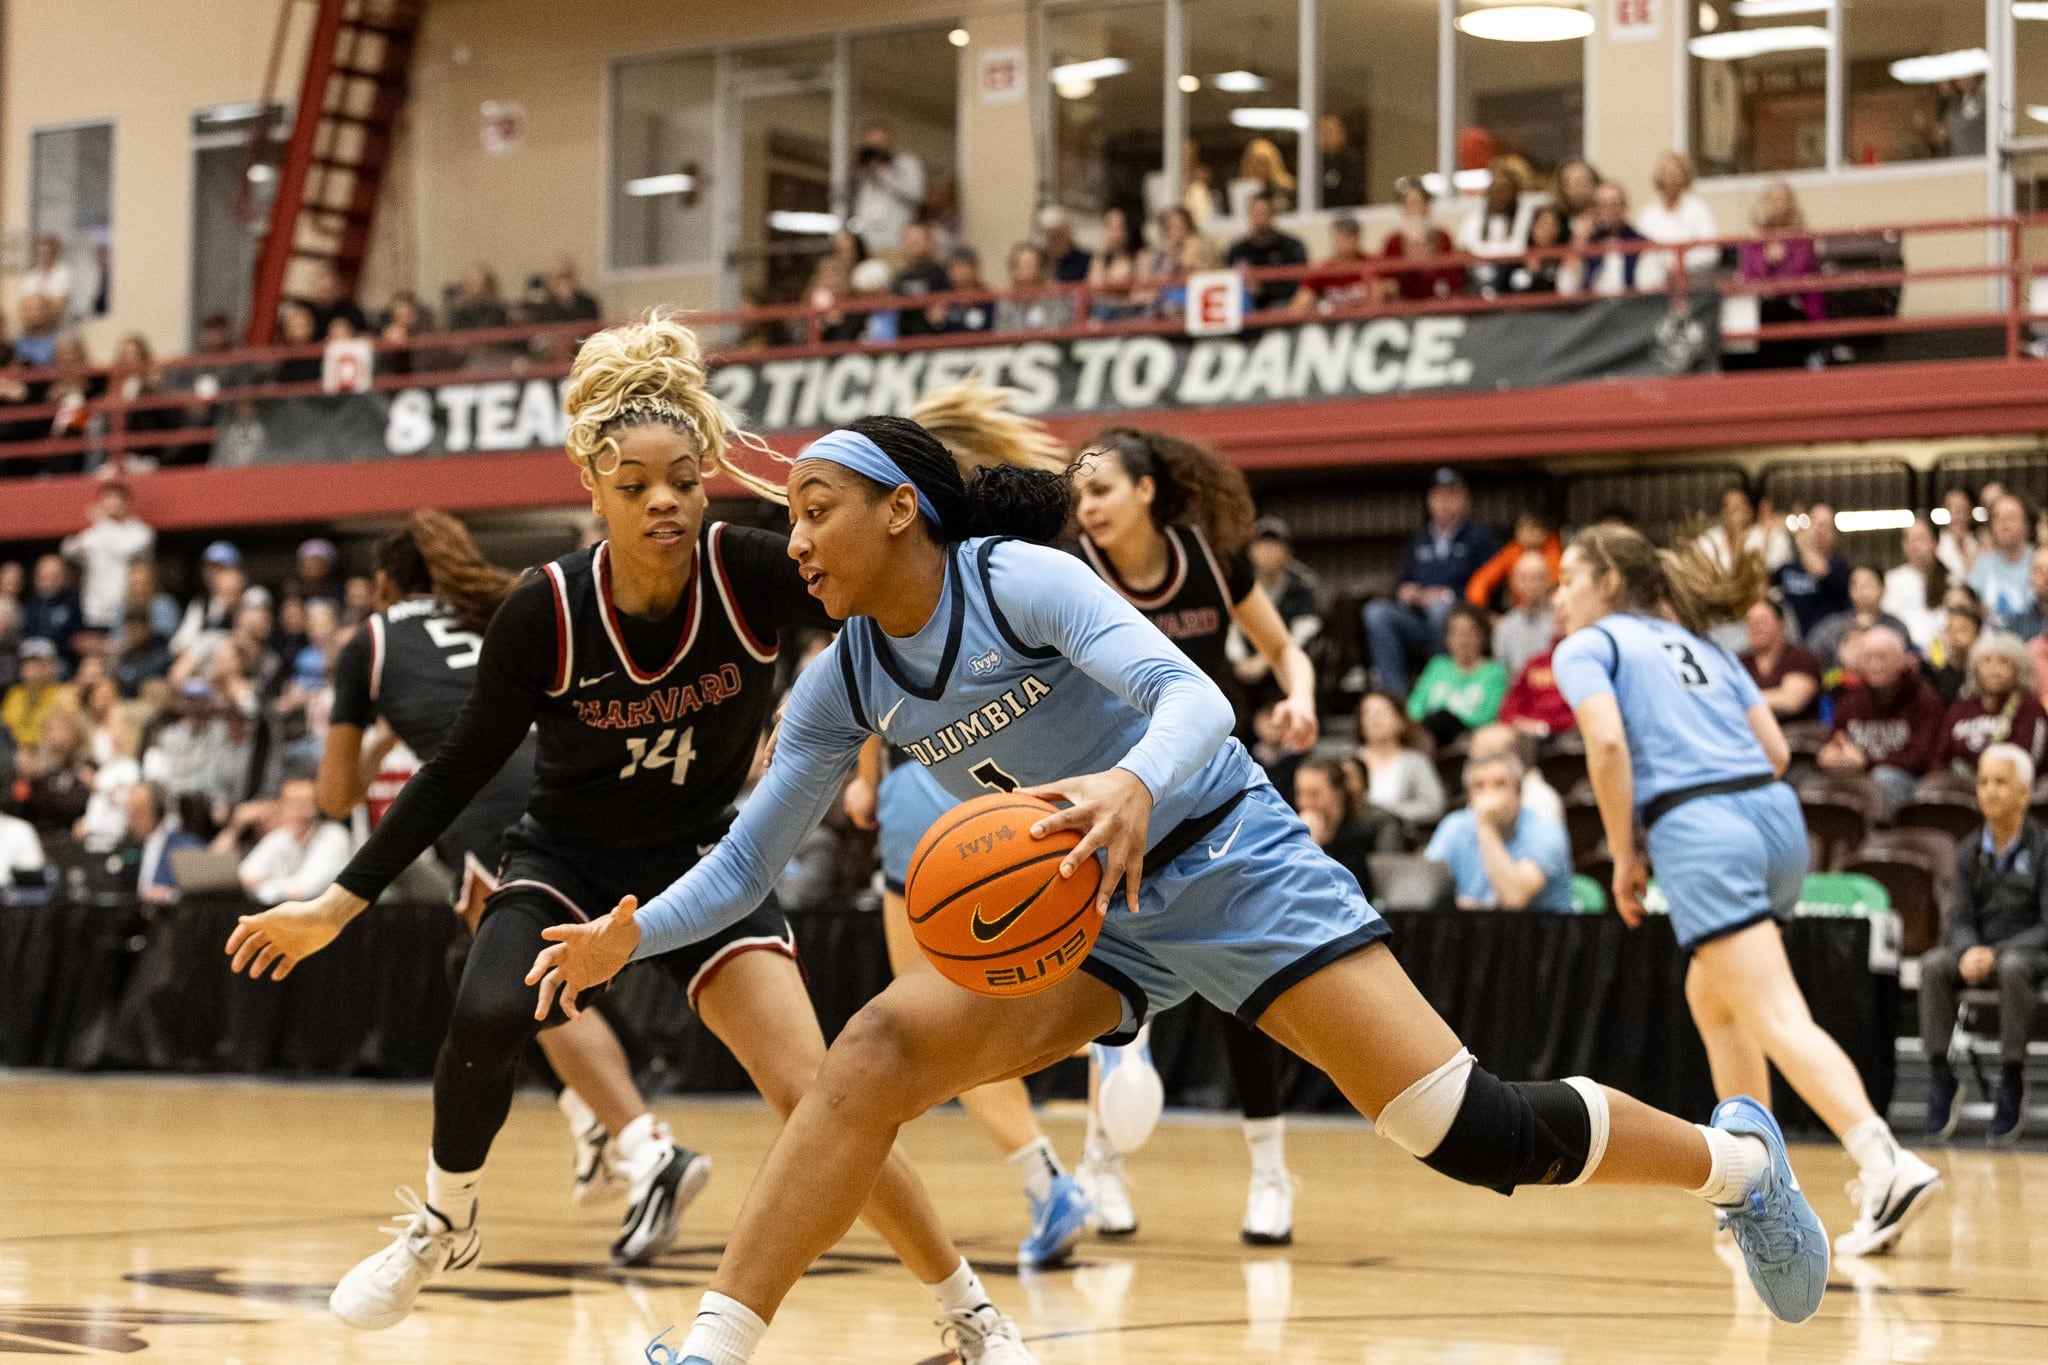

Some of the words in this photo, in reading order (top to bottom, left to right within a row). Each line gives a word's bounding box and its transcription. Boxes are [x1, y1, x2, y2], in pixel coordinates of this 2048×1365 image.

[1200, 286, 1228, 324] E
[384, 388, 435, 454] 8
[436, 378, 571, 452] TEA
[760, 341, 1061, 429] TICKETS
[1071, 335, 1176, 410] TO
[1176, 315, 1473, 403] DANCE.
[423, 618, 484, 669] 5
[1663, 643, 1709, 685] 3
[572, 662, 743, 729] HARVARD
[903, 674, 1053, 767] OLUMBIA
[619, 726, 697, 785] 14
[984, 928, 1087, 986] ELITE
